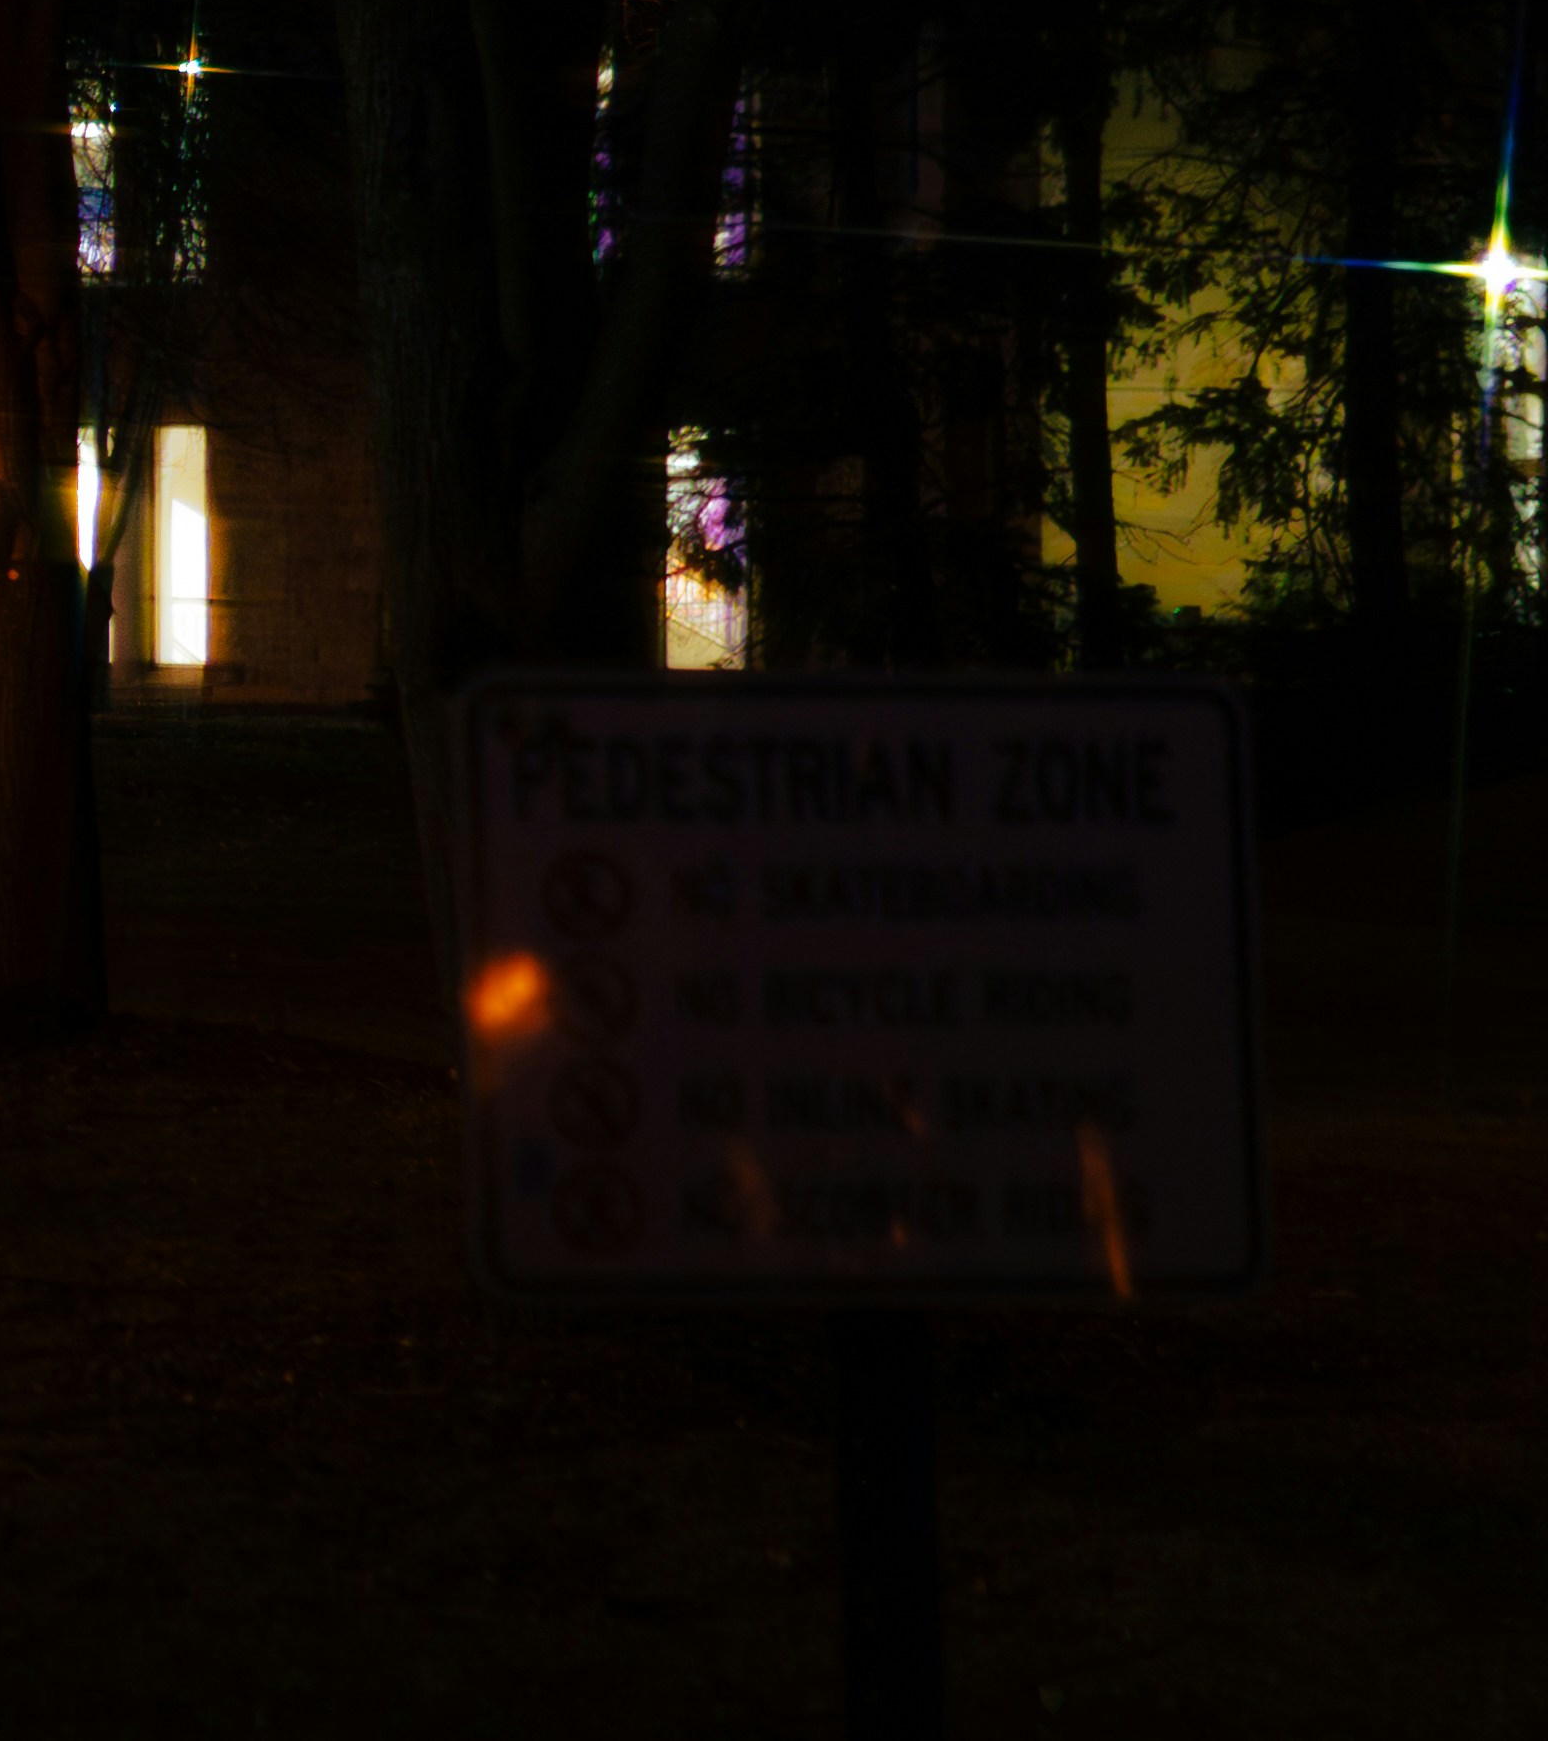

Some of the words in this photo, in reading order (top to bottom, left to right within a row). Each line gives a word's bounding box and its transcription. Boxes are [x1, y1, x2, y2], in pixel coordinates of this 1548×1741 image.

[510, 732, 954, 824] PEDESTRIAN
[990, 736, 1176, 826] ZONE
[669, 864, 737, 921] NO
[761, 864, 1141, 922] SKATEBOARDING
[674, 969, 739, 1026] NO
[762, 967, 957, 1027] BICYCLE
[980, 968, 1134, 1026] RIDING
[678, 1074, 745, 1131] NO
[941, 1074, 1137, 1132] SKATING
